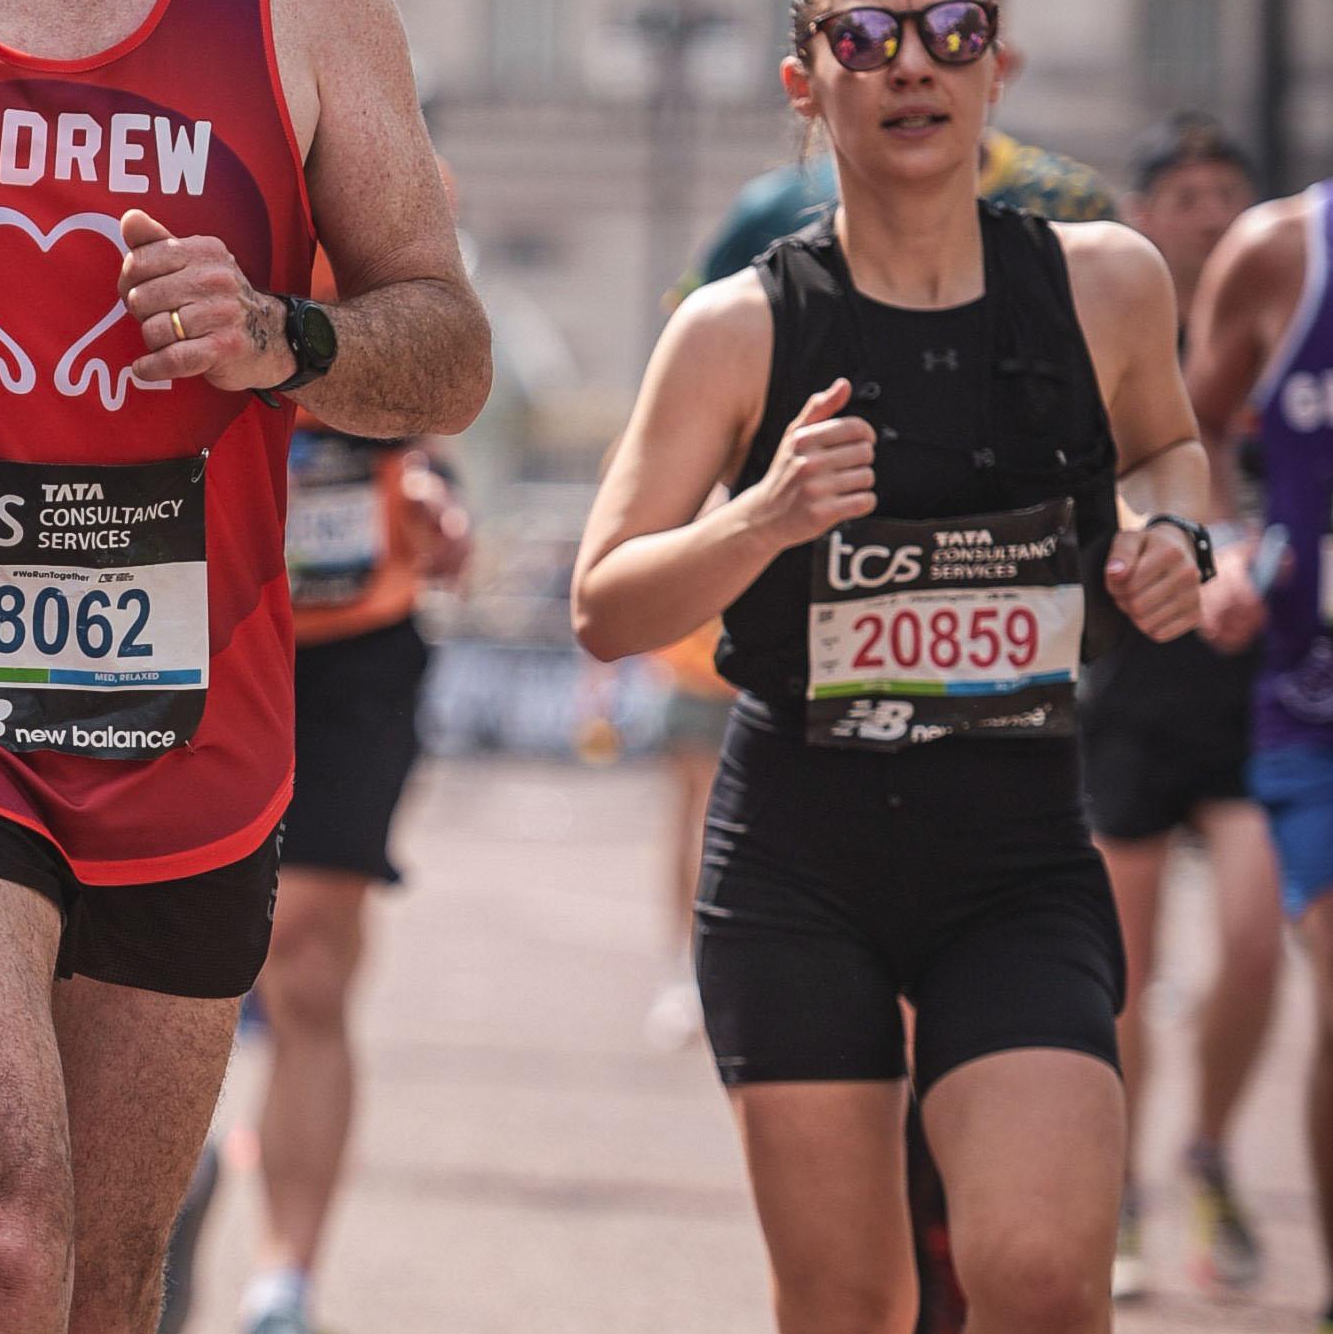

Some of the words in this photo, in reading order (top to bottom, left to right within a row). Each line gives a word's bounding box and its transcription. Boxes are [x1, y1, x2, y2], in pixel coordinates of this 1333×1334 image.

[41, 483, 104, 502] TATA
[39, 499, 183, 527] CONSULTANCY
[38, 530, 131, 549] SERVICES
[934, 530, 993, 547] TATA
[827, 530, 923, 590] tcs
[13, 570, 90, 582] #WeRunTogether
[930, 562, 1017, 580] SERVICES
[853, 608, 1038, 668] 20859
[119, 672, 160, 681] RELAXED
[15, 727, 66, 745] new
[72, 725, 176, 748] balance
